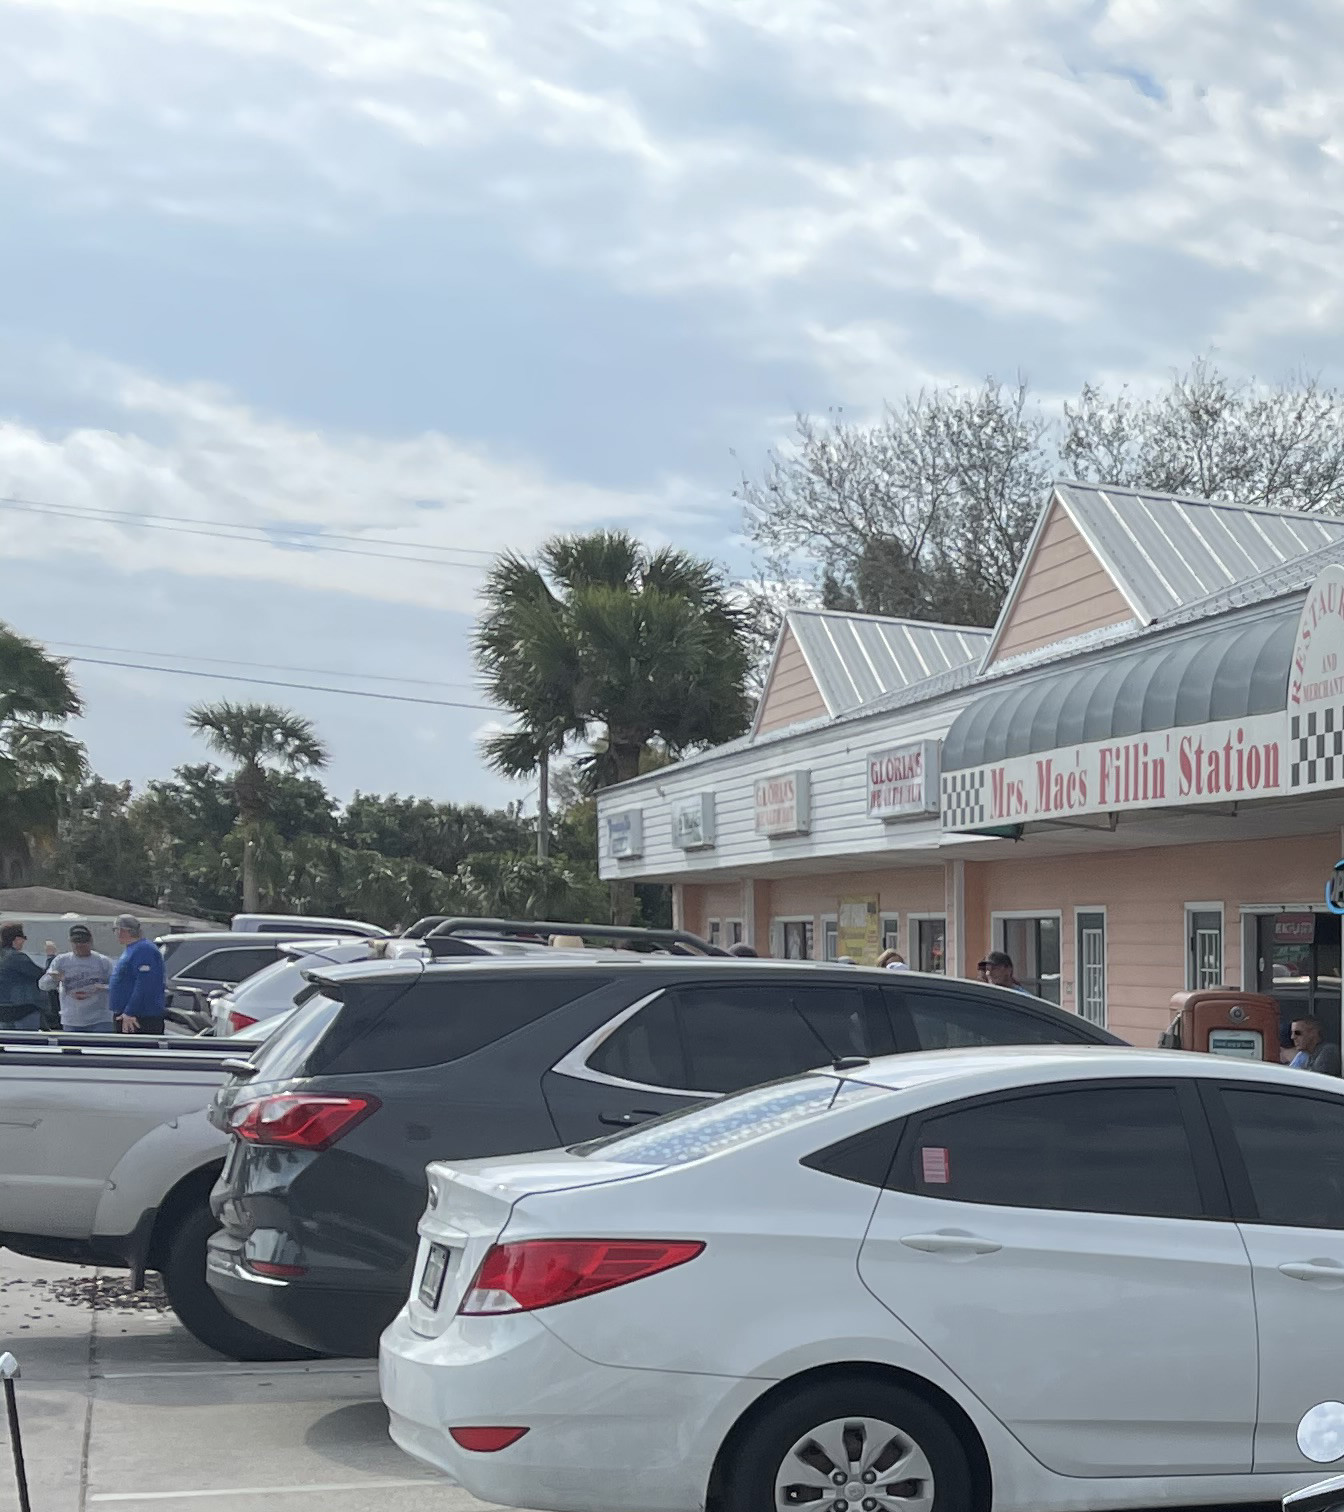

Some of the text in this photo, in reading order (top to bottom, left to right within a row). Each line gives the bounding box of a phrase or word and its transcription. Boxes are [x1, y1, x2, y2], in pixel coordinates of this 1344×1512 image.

[989, 727, 1281, 820] Mrs. Mac's Fillin' Station
